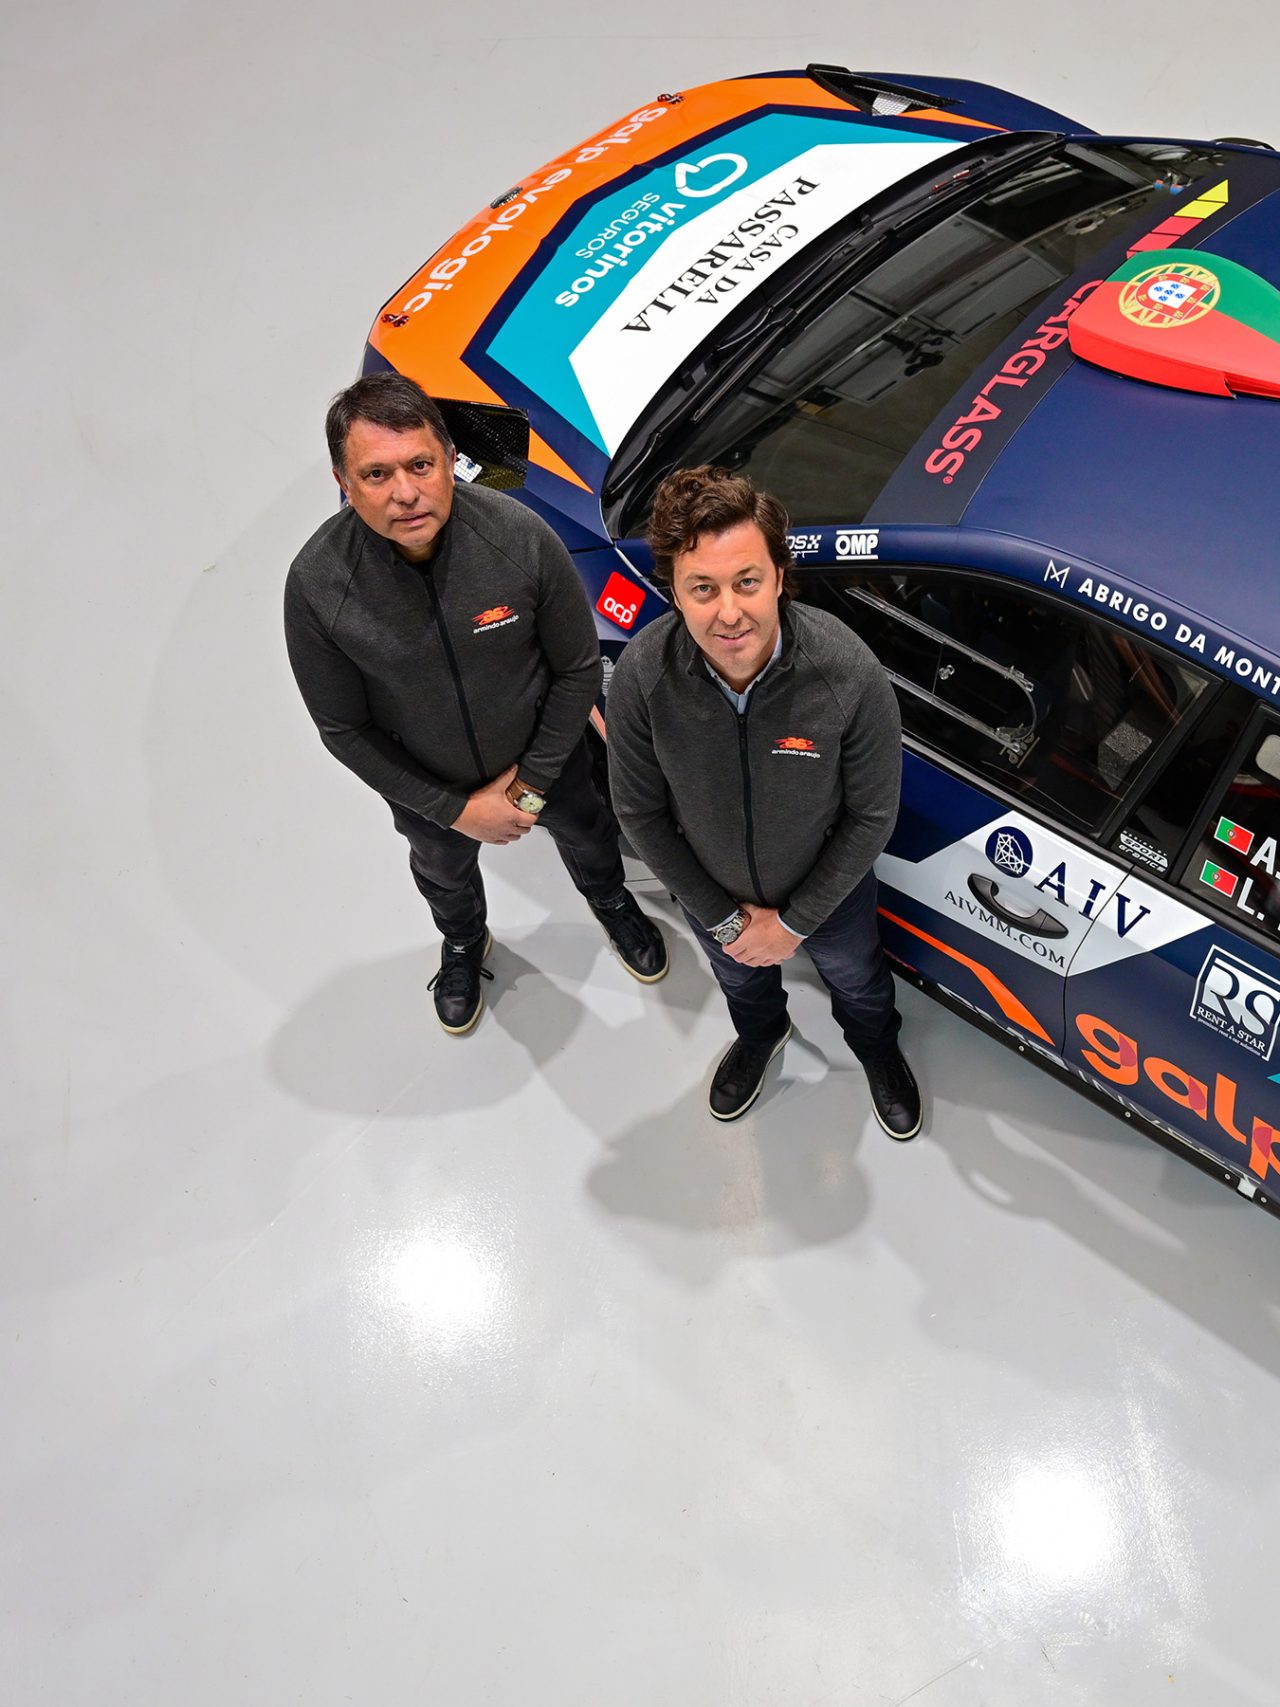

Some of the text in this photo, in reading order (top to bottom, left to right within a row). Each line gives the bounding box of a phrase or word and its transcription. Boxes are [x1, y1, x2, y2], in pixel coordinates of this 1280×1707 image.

[403, 107, 667, 313] galp evologic
[575, 192, 661, 259] SEGUROS
[554, 201, 686, 307] vitorinos
[620, 175, 821, 332] PASSARELLA
[694, 224, 799, 305] CASA DA
[835, 533, 879, 556] OMP
[1077, 578, 1168, 632] ABRIGO
[1174, 624, 1206, 653] DA
[1123, 838, 1165, 862] SPORT
[944, 890, 1065, 968] AIVMM.COM
[1034, 861, 1151, 938] AIV
[1236, 876, 1265, 922] L.
[1196, 1005, 1266, 1052] RENT A STAR
[1202, 962, 1280, 1035] RS
